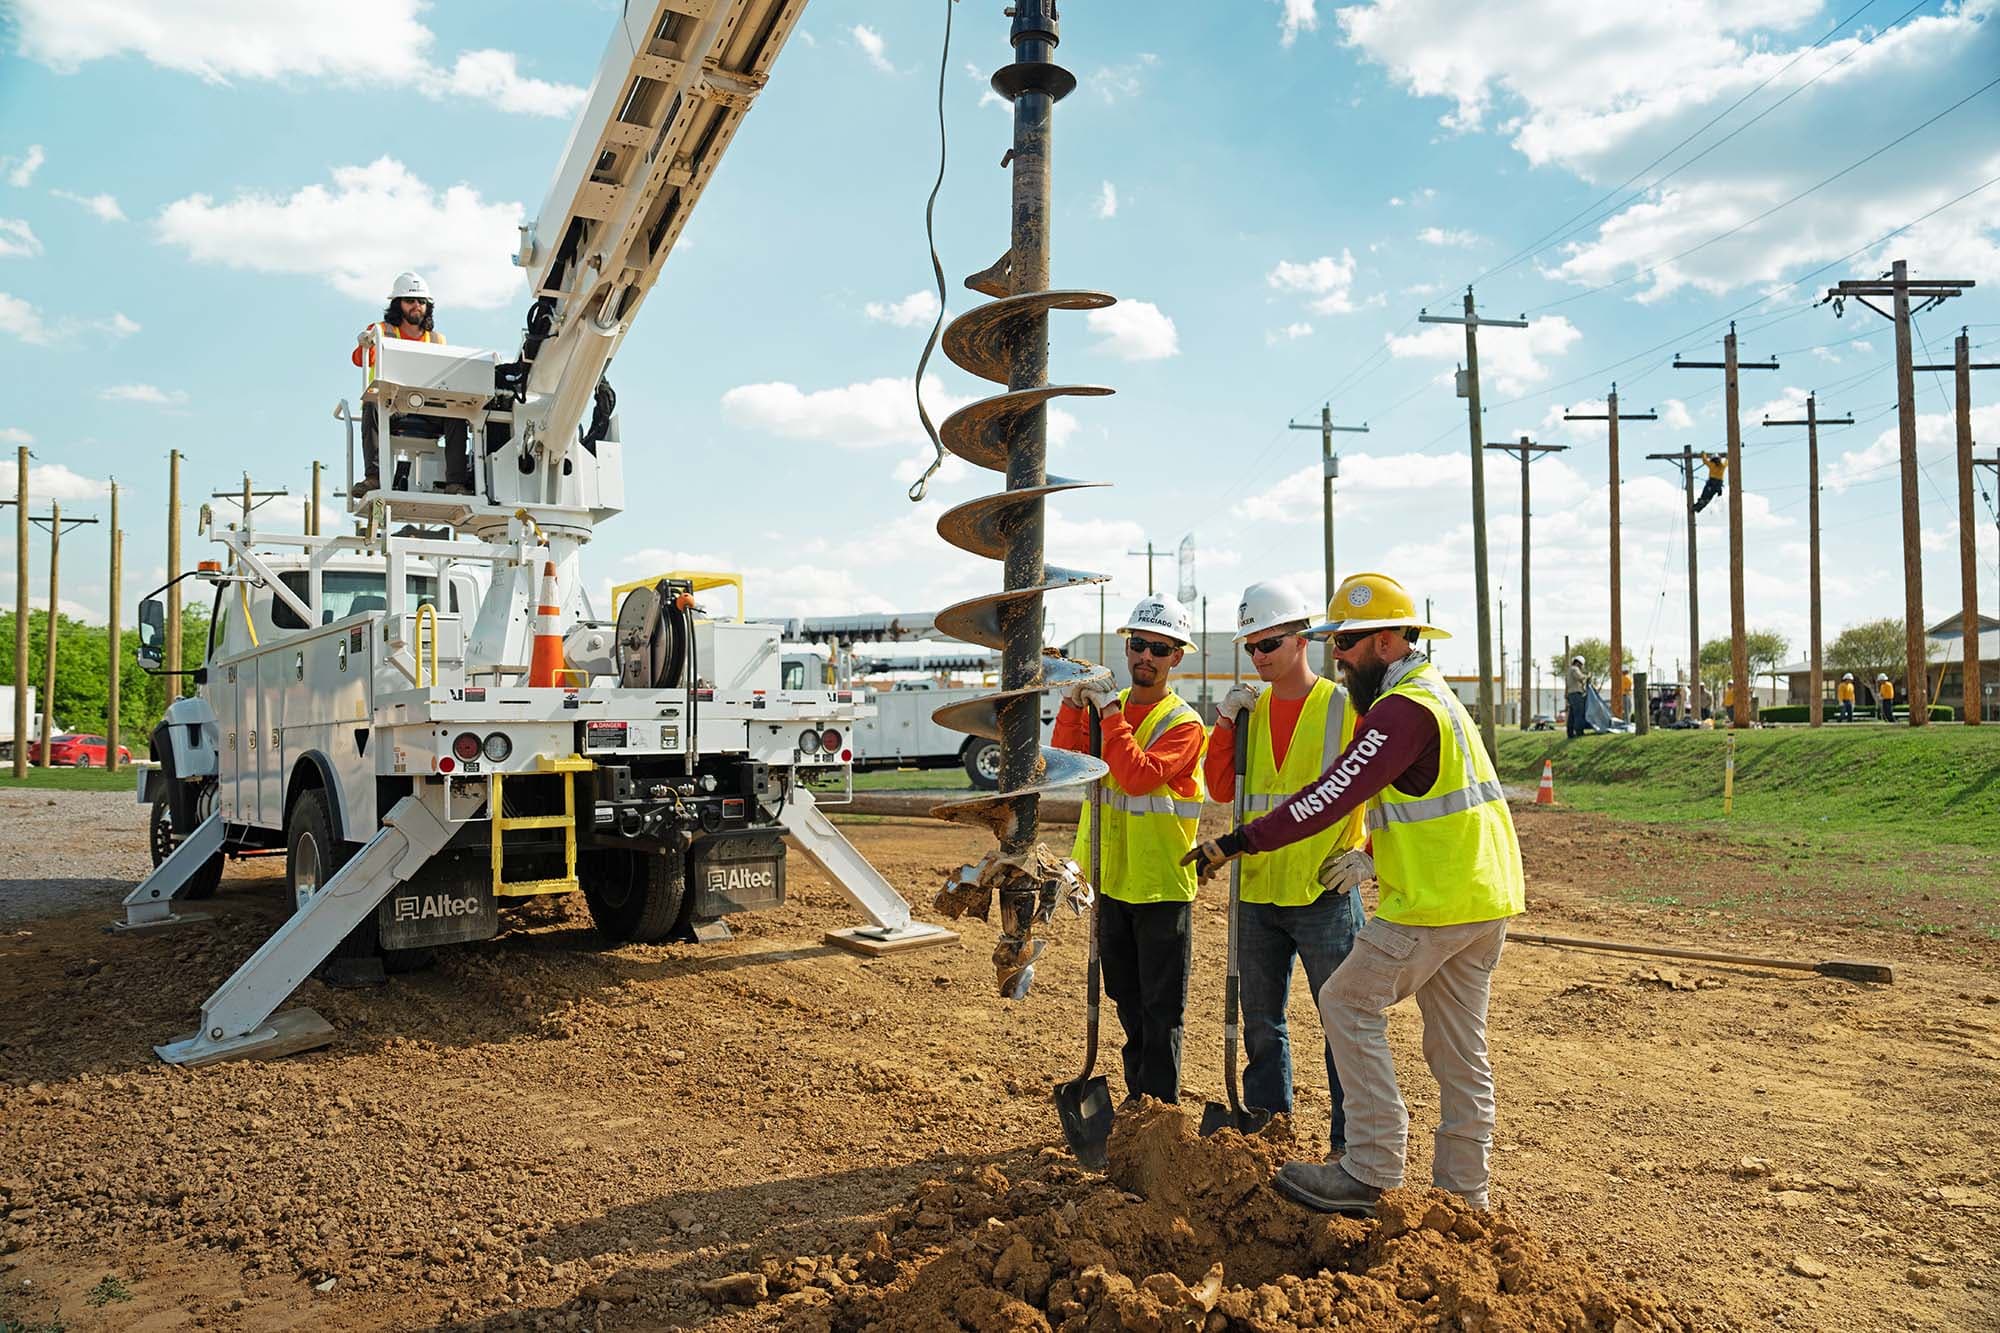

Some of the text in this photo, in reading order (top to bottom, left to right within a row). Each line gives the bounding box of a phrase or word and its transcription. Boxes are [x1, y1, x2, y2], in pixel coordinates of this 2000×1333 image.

[1137, 616, 1172, 628] PRECIADO
[1288, 728, 1389, 823] INSTRUCTOR
[728, 868, 772, 890] Altec
[421, 894, 479, 919] Altec
